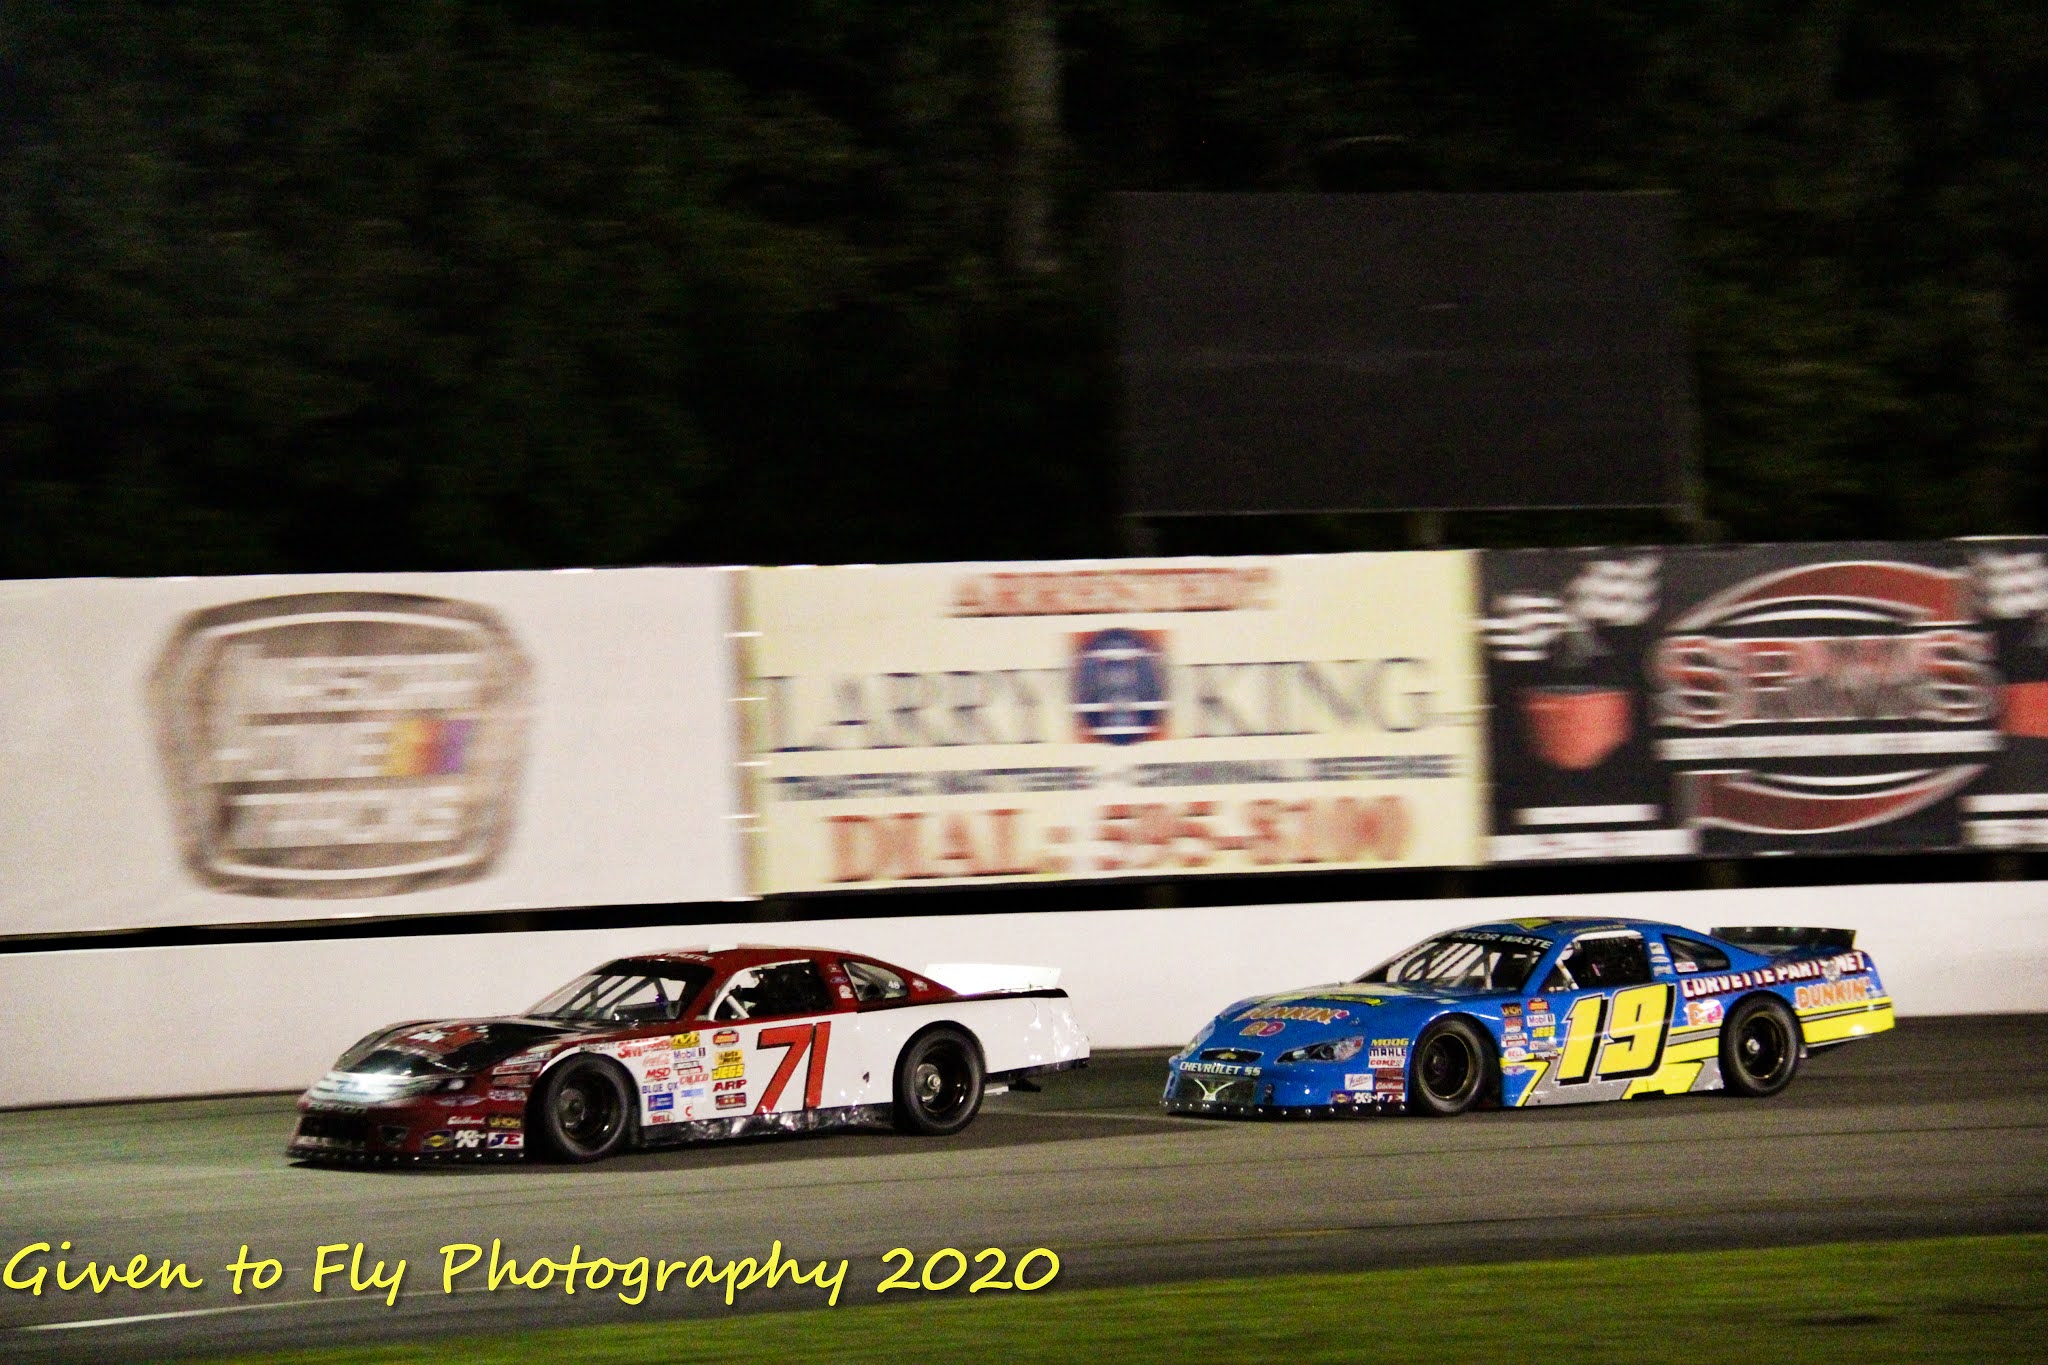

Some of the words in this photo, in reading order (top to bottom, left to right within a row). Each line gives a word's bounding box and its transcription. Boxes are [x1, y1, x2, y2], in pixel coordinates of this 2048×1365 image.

[1182, 658, 1436, 734] KING
[1554, 982, 1676, 1086] 19
[1371, 1037, 1409, 1047] MOOG
[673, 1048, 697, 1061] Mobil
[1369, 1047, 1406, 1057] MAHLE
[645, 1067, 672, 1080] MSD
[715, 1064, 745, 1080] JEGS
[753, 1021, 831, 1114] 71
[1180, 1061, 1242, 1075] CHEVROLET
[1244, 1066, 1262, 1076] SS
[641, 1084, 664, 1095] BLUE
[713, 1079, 747, 1092] ARP
[652, 1114, 673, 1124] BELL
